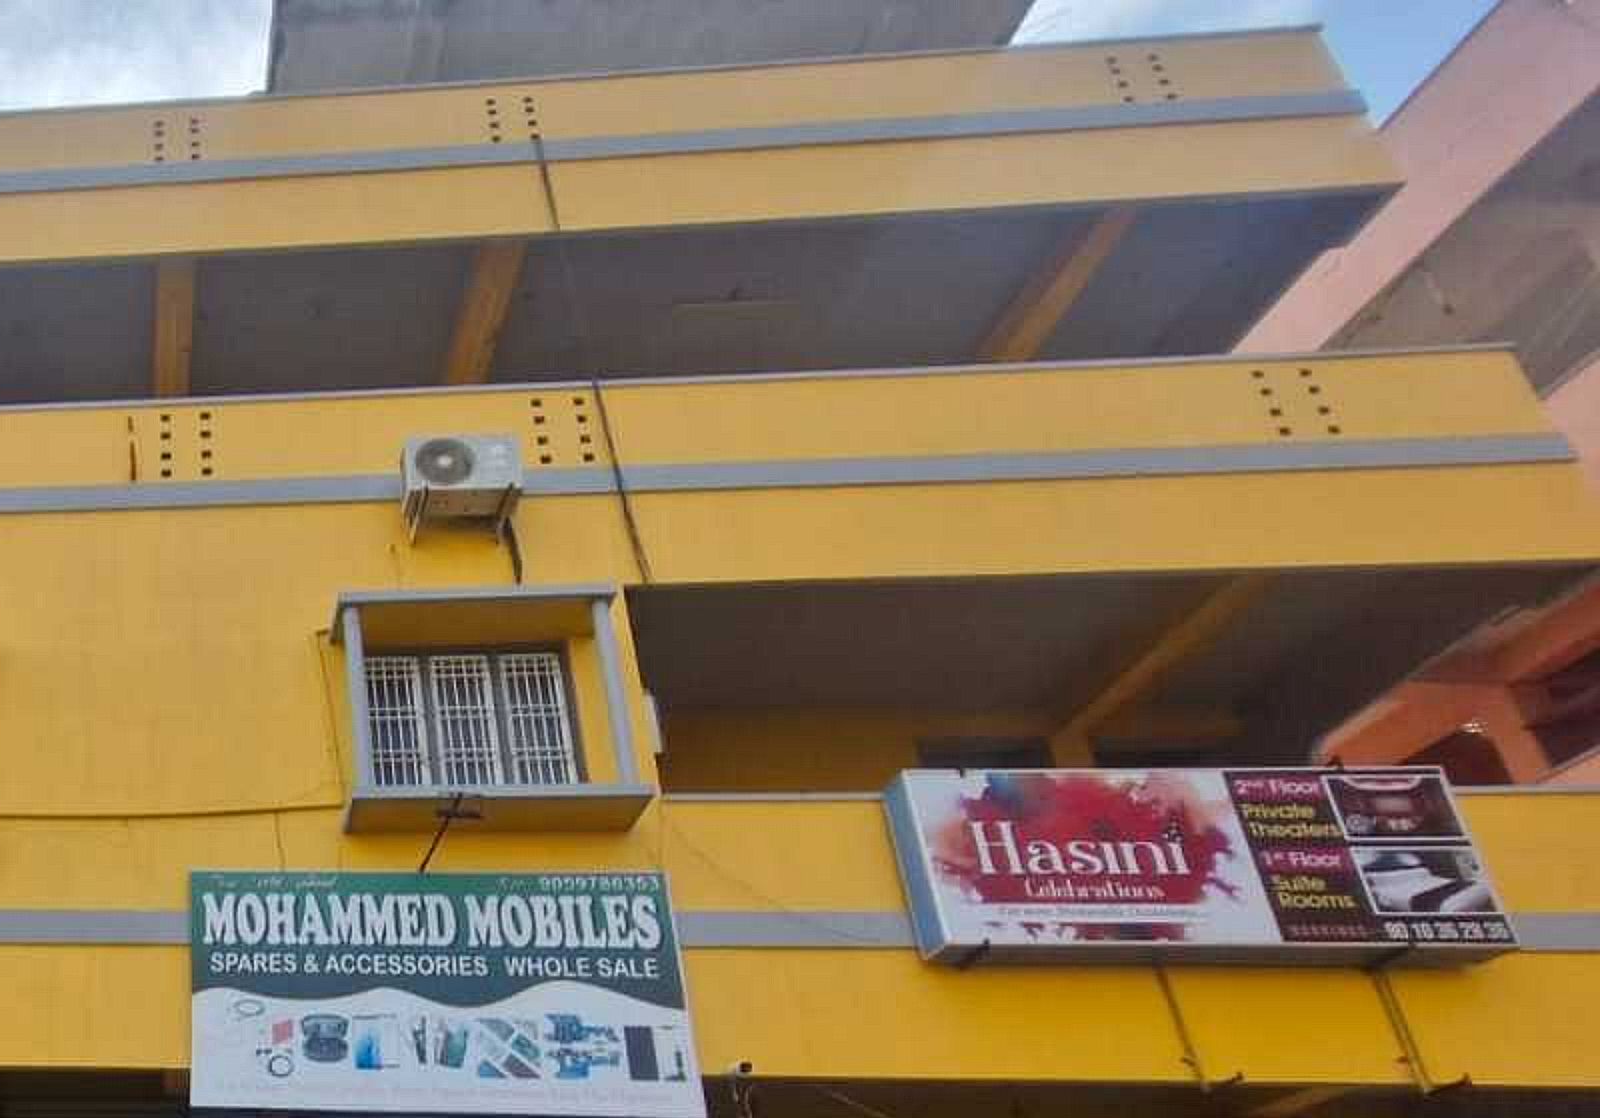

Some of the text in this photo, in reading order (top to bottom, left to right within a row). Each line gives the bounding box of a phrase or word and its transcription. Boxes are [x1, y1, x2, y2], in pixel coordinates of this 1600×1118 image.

[969, 819, 1191, 876] Hasini
[1288, 851, 1340, 866] Floor
[1280, 893, 1358, 909] Rooms
[203, 891, 662, 950] MOHAMMED MOBILES
[209, 952, 660, 979] SPARES & ACCESSORIES WHOLE SALE
